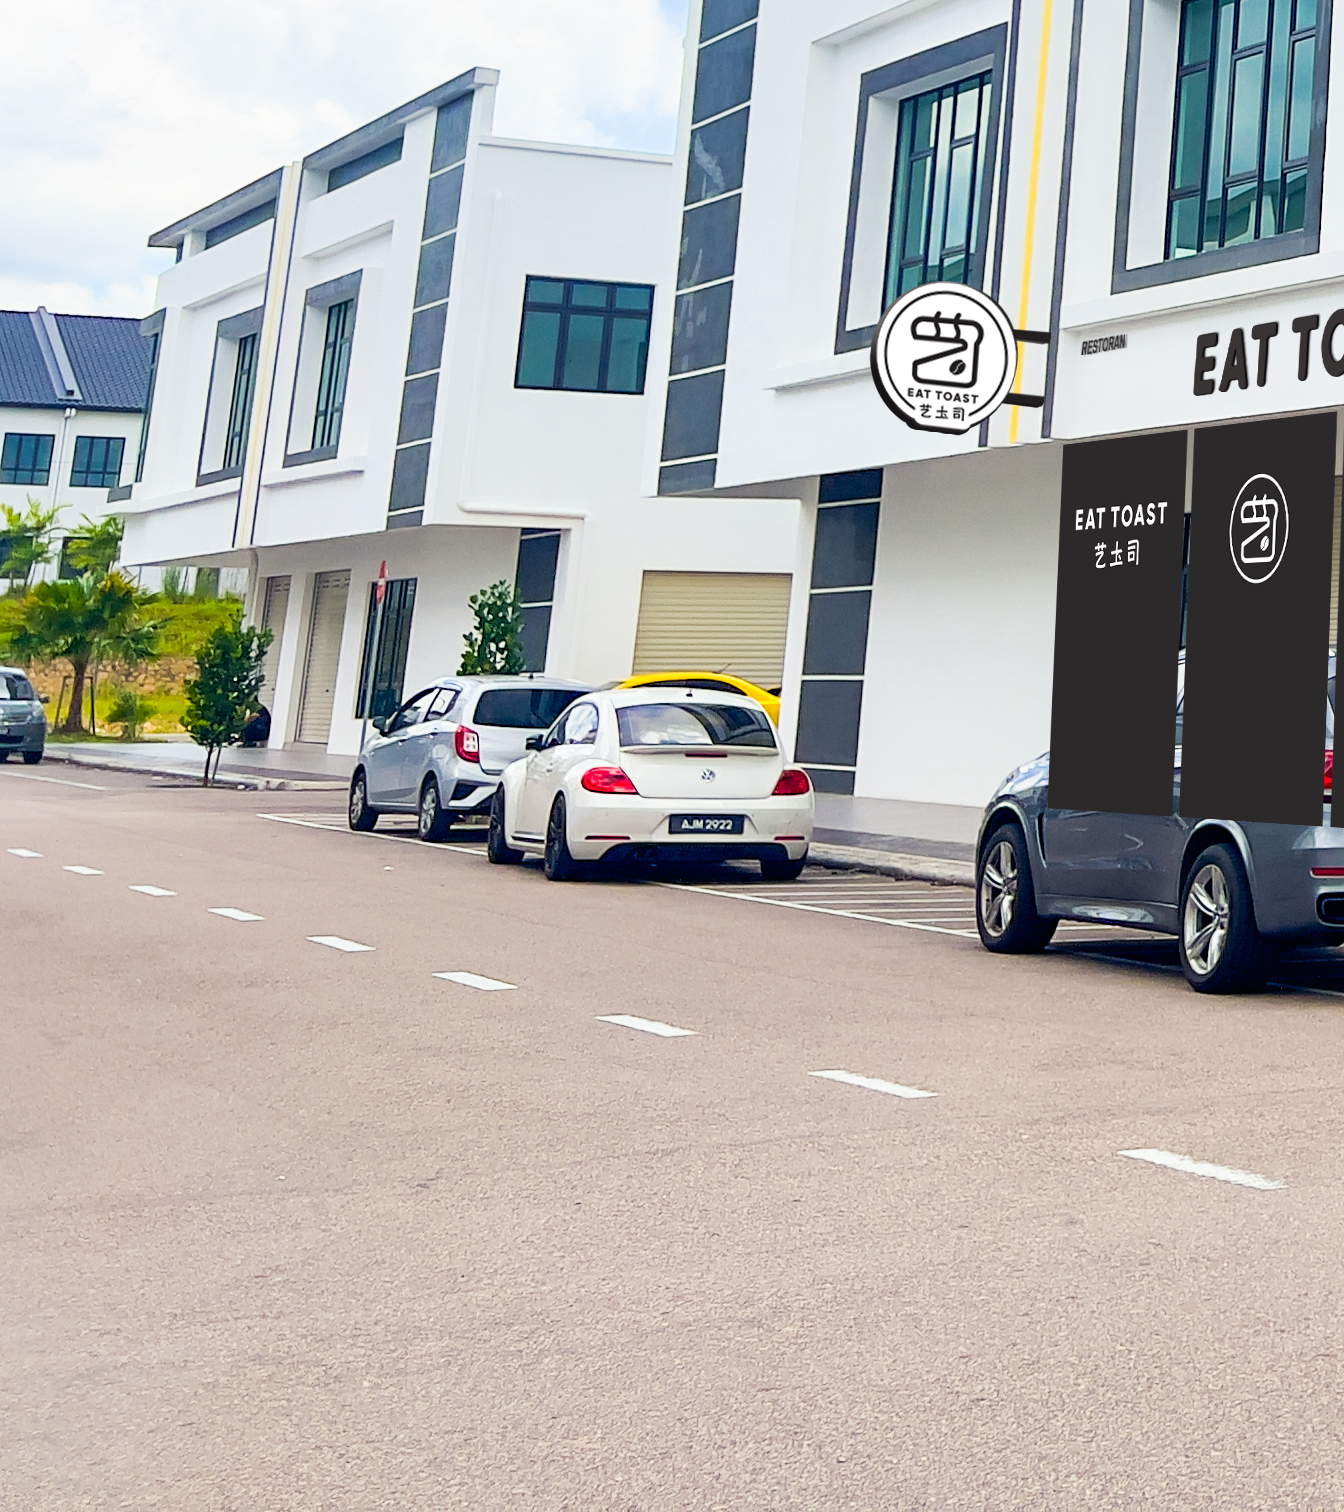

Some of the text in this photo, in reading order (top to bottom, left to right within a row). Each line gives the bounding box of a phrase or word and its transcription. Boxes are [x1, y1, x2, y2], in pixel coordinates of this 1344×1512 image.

[1081, 333, 1128, 356] RESTORAN
[1193, 321, 1280, 397] EAT
[907, 387, 979, 404] EAT TOAST
[1075, 501, 1168, 531] EAT TOAST
[681, 819, 733, 830] AJM 2922
